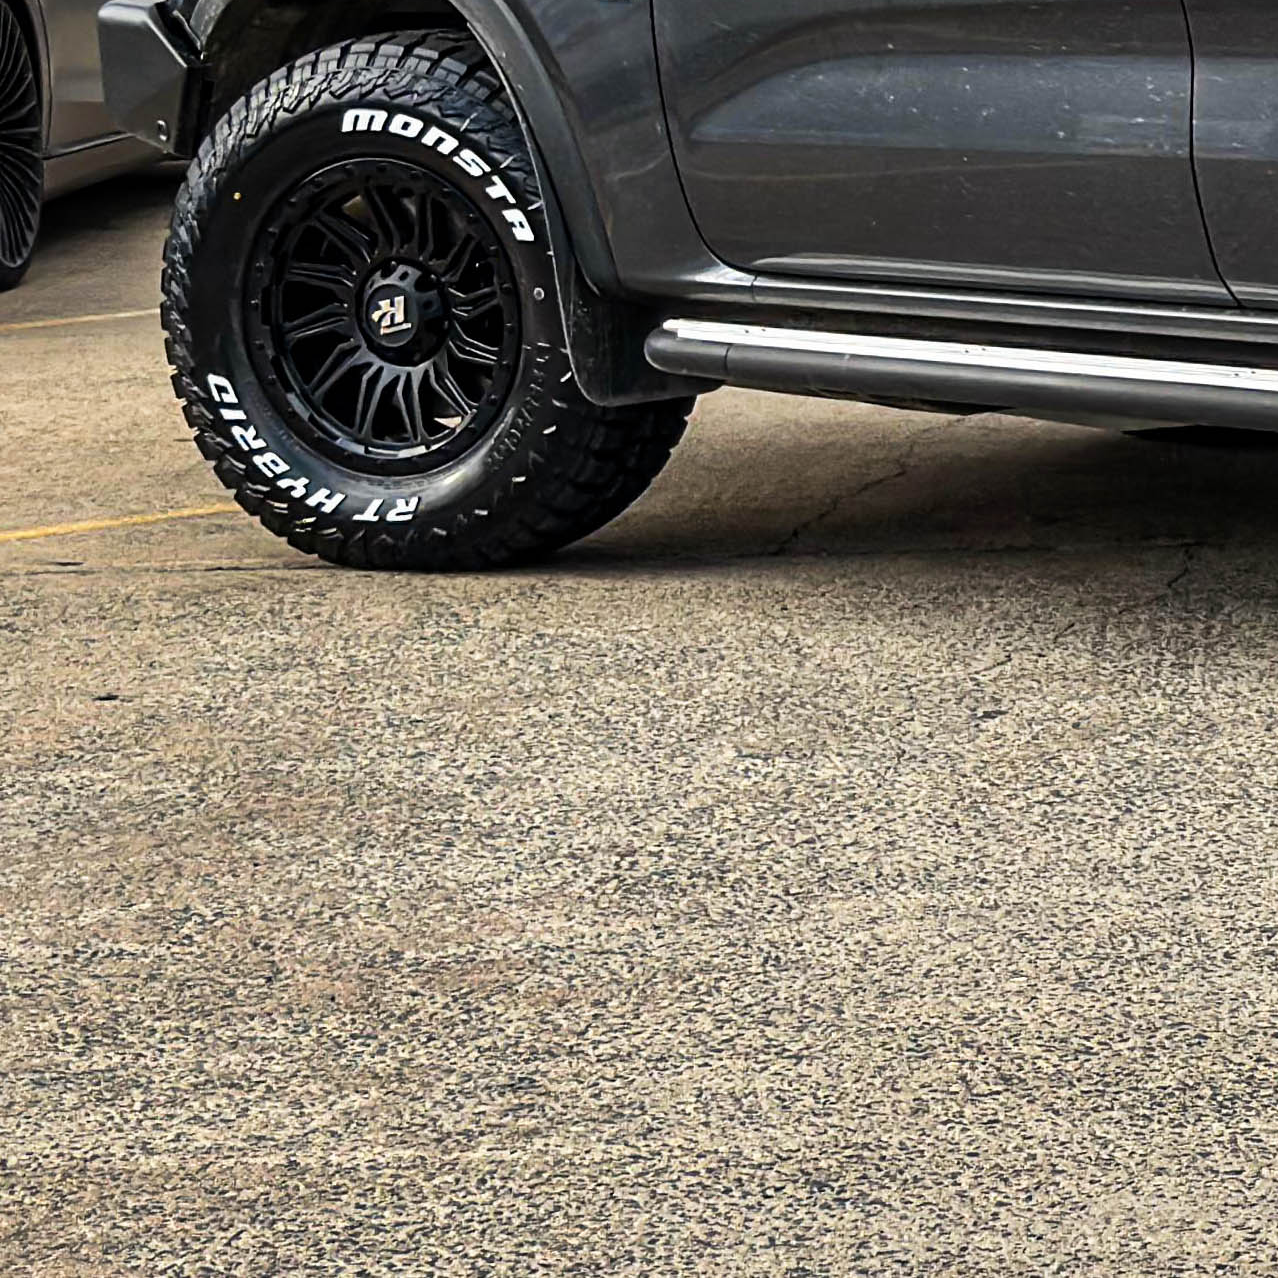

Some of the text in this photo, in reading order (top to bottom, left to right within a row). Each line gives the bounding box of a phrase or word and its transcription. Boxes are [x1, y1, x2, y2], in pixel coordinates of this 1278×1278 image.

[341, 109, 535, 242] MONSTA
[206, 373, 421, 522] RT HYBRID
